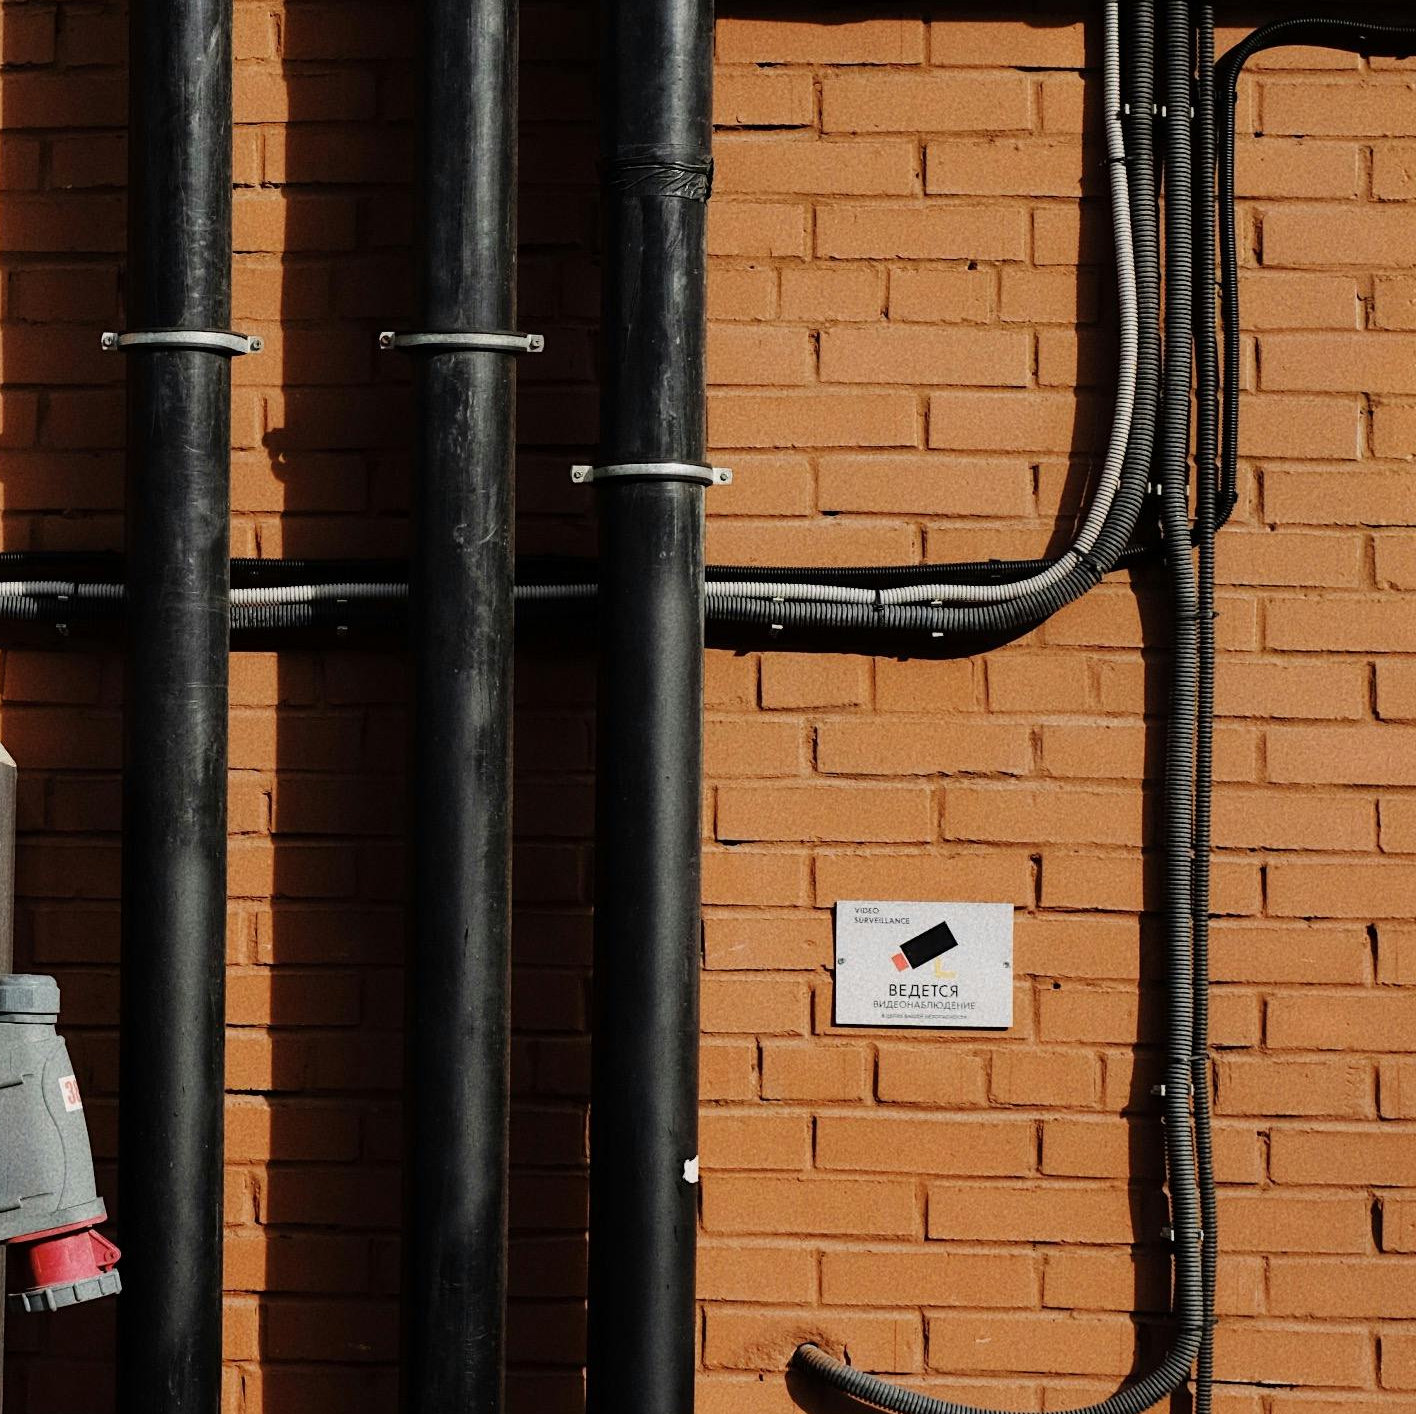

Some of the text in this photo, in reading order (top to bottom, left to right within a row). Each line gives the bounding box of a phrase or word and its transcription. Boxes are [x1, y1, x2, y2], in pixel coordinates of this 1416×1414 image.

[854, 917, 910, 925] SURVEILLANCE
[889, 983, 958, 998] ВЕДЕТСЯ
[873, 1000, 976, 1010] ВИДЕОНАБЛЮДЕНИЕ
